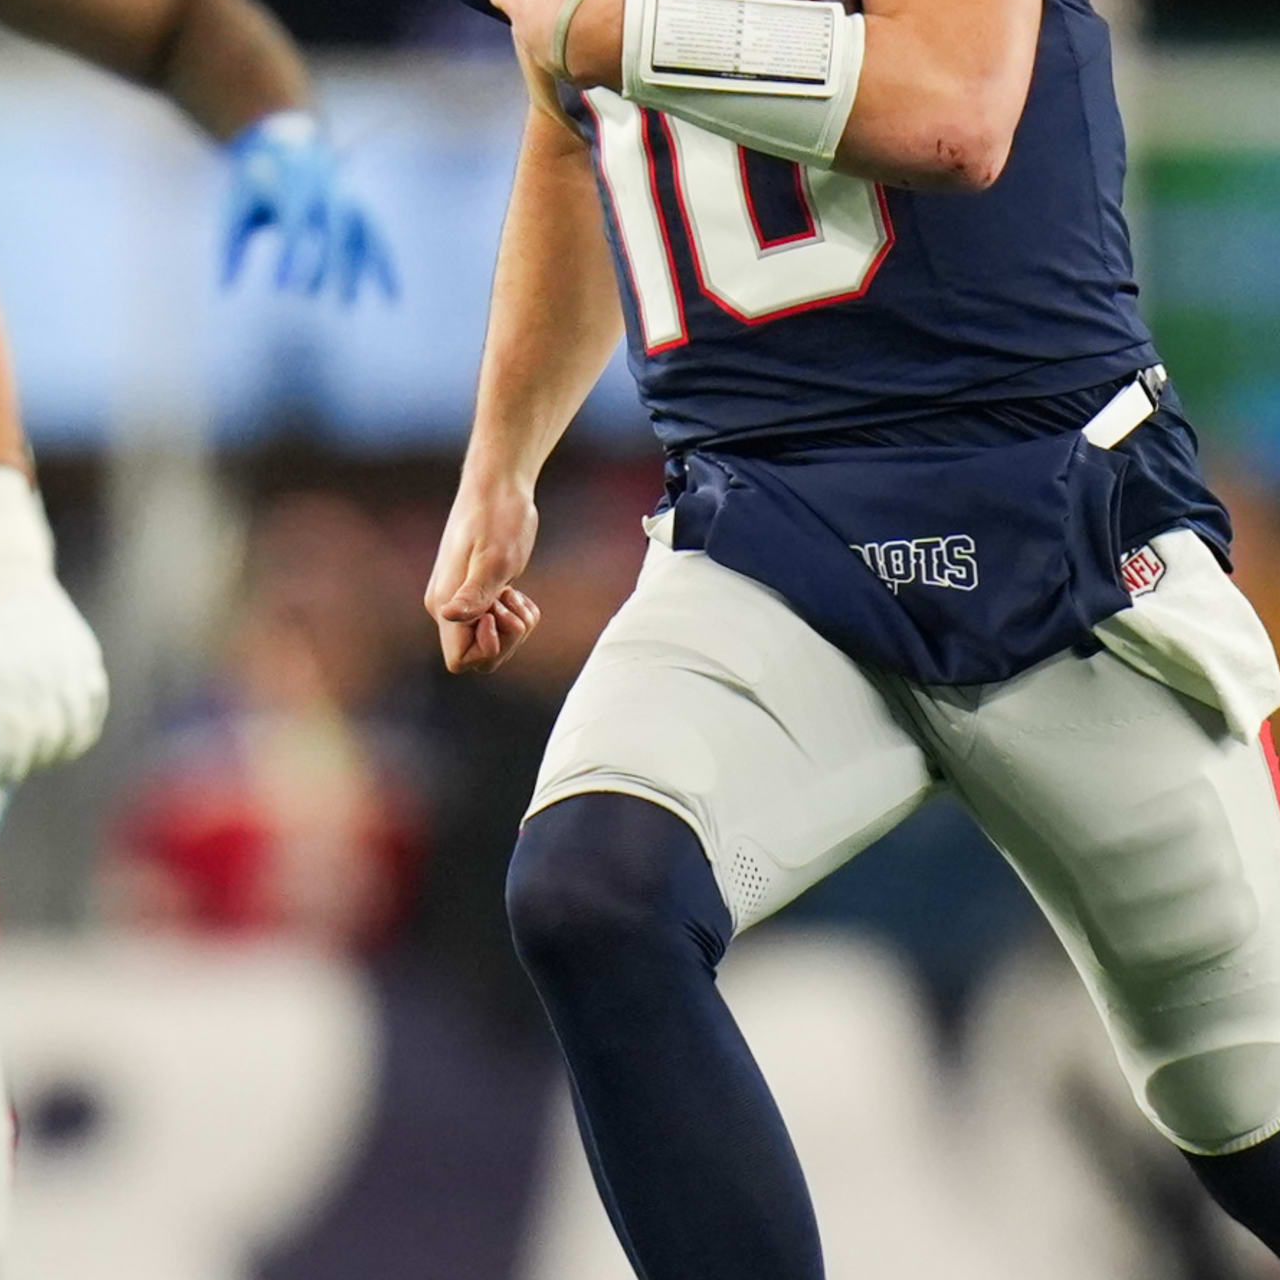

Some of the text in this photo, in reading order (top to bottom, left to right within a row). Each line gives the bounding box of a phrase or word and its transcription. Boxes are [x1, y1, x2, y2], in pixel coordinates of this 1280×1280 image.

[579, 88, 896, 357] 10
[848, 534, 979, 596] IOTS
[1121, 551, 1162, 592] NFL
